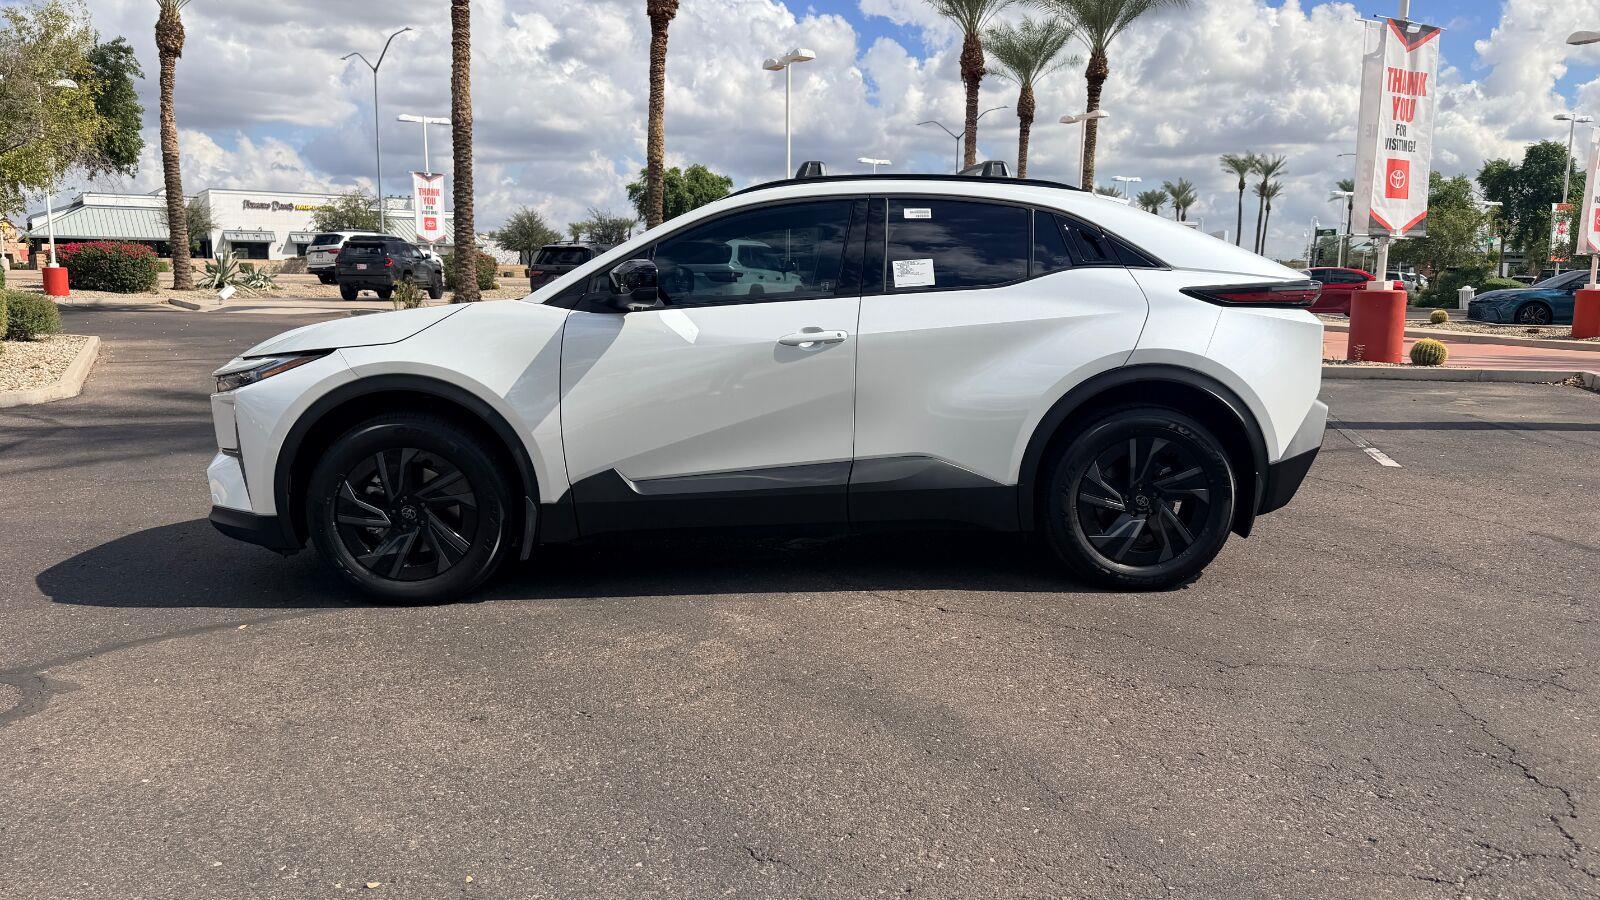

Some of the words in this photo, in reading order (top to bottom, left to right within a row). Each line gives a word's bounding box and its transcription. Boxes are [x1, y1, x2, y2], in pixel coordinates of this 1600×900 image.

[1387, 67, 1428, 97] THANK
[1392, 96, 1416, 123] YOU
[1395, 123, 1407, 137] FOR
[1384, 137, 1416, 153] VISITING!
[417, 187, 440, 197] THANK
[422, 196, 436, 205] YOU
